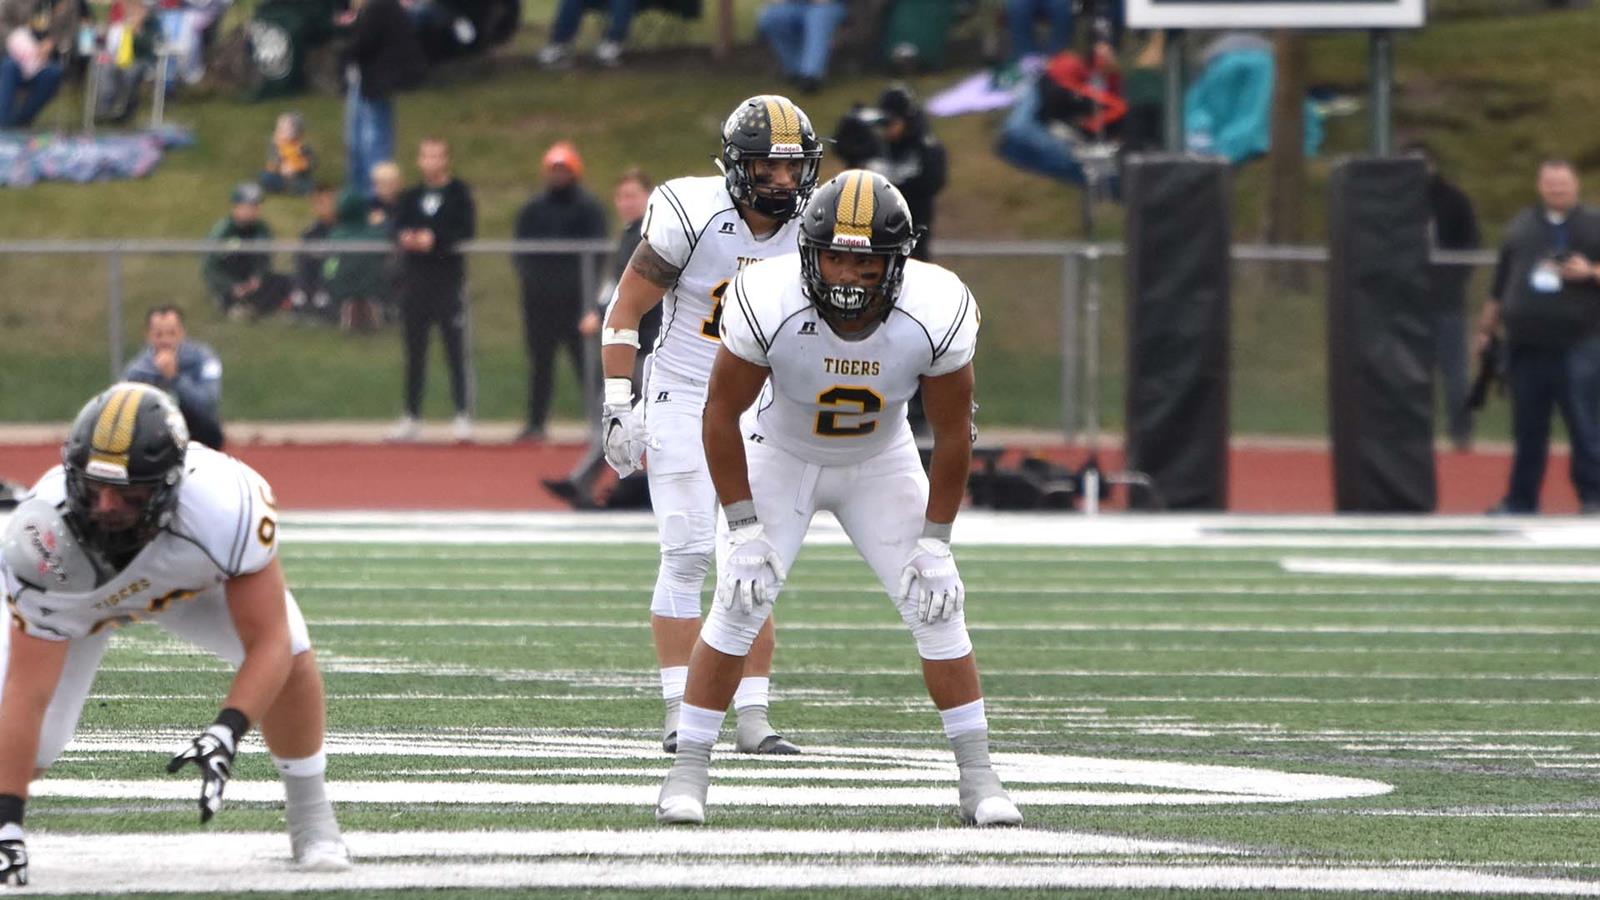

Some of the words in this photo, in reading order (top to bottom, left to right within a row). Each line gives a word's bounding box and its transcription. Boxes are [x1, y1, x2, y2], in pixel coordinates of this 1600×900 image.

[837, 237, 867, 247] Riddell
[823, 357, 881, 376] TIGERS
[812, 384, 885, 439] 2
